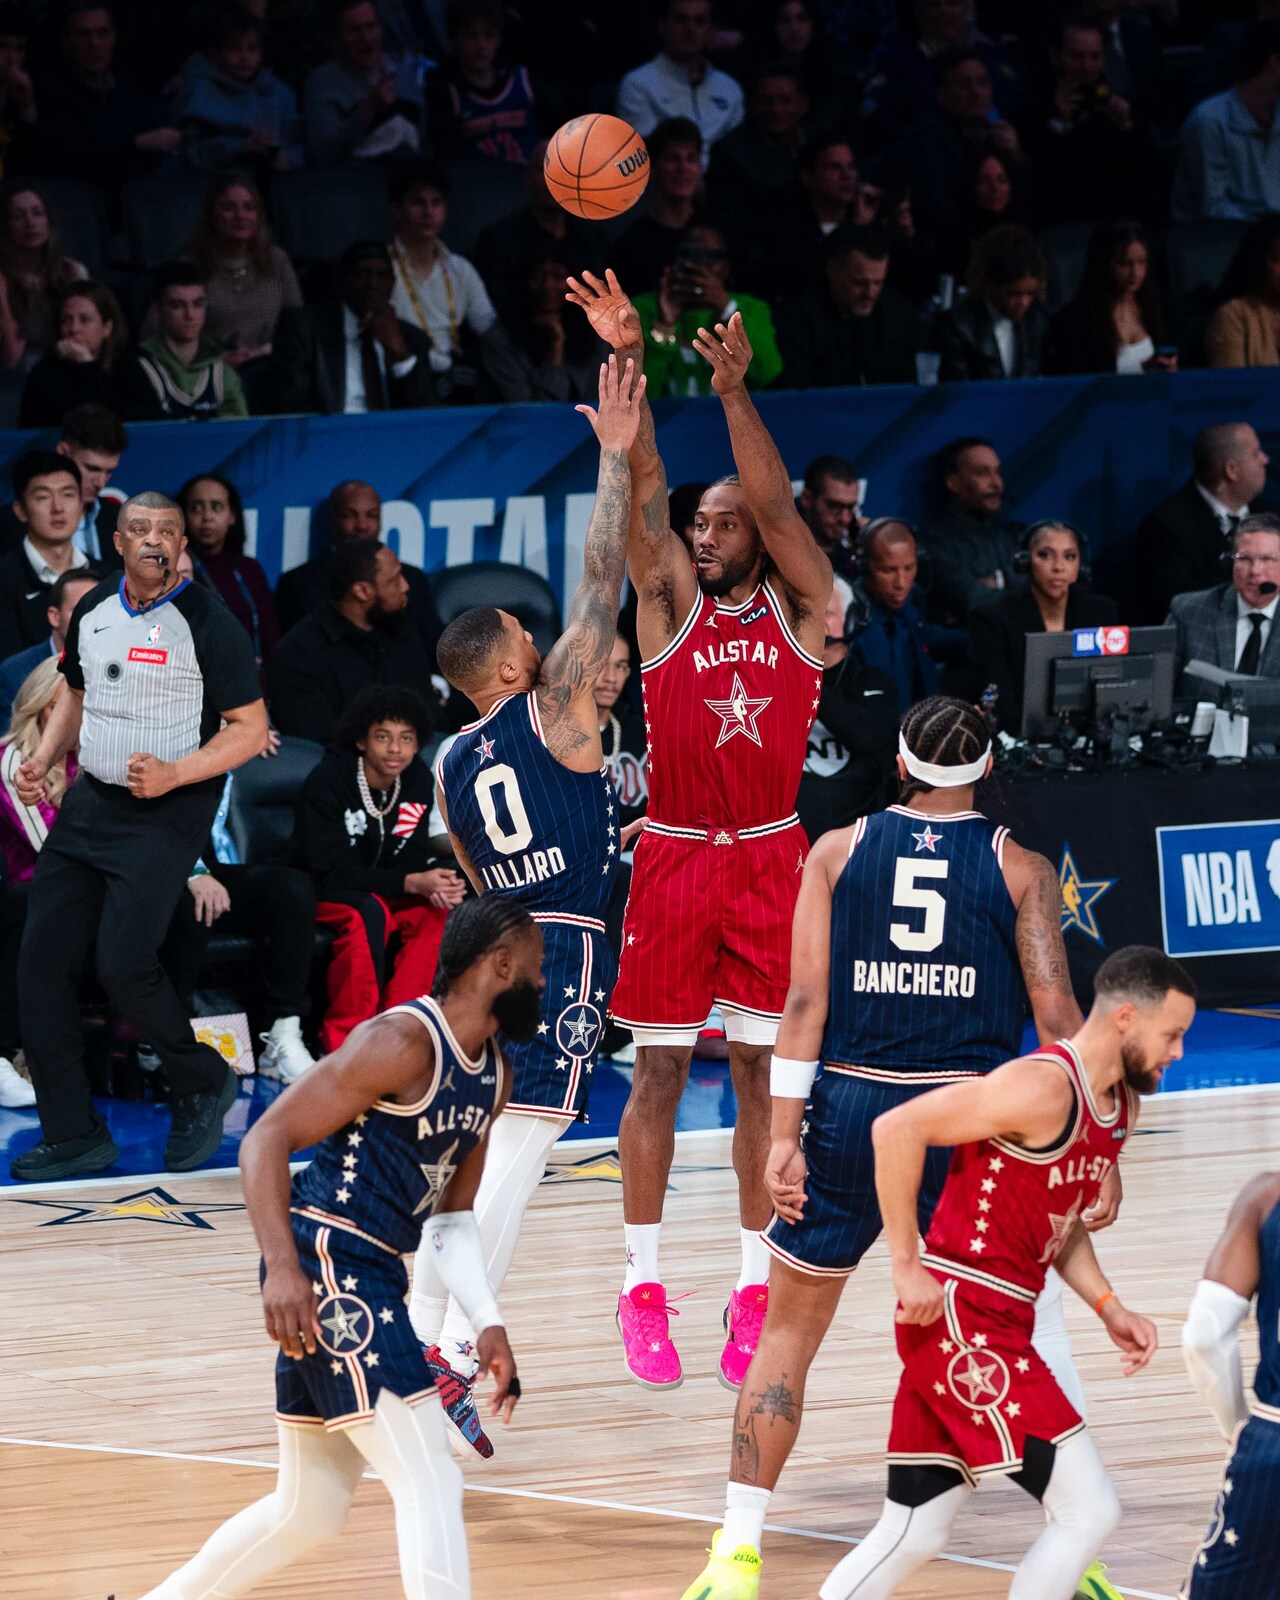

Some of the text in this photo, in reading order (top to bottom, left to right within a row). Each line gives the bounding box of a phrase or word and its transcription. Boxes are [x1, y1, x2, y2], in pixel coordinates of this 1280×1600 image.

[131, 650, 164, 662] Emirates
[474, 762, 533, 855] 0
[481, 846, 567, 890] LILLARD
[1181, 849, 1262, 927] NBA
[889, 856, 949, 952] 5
[853, 959, 977, 998] BANCHERO
[417, 1104, 491, 1144] ALL-STA
